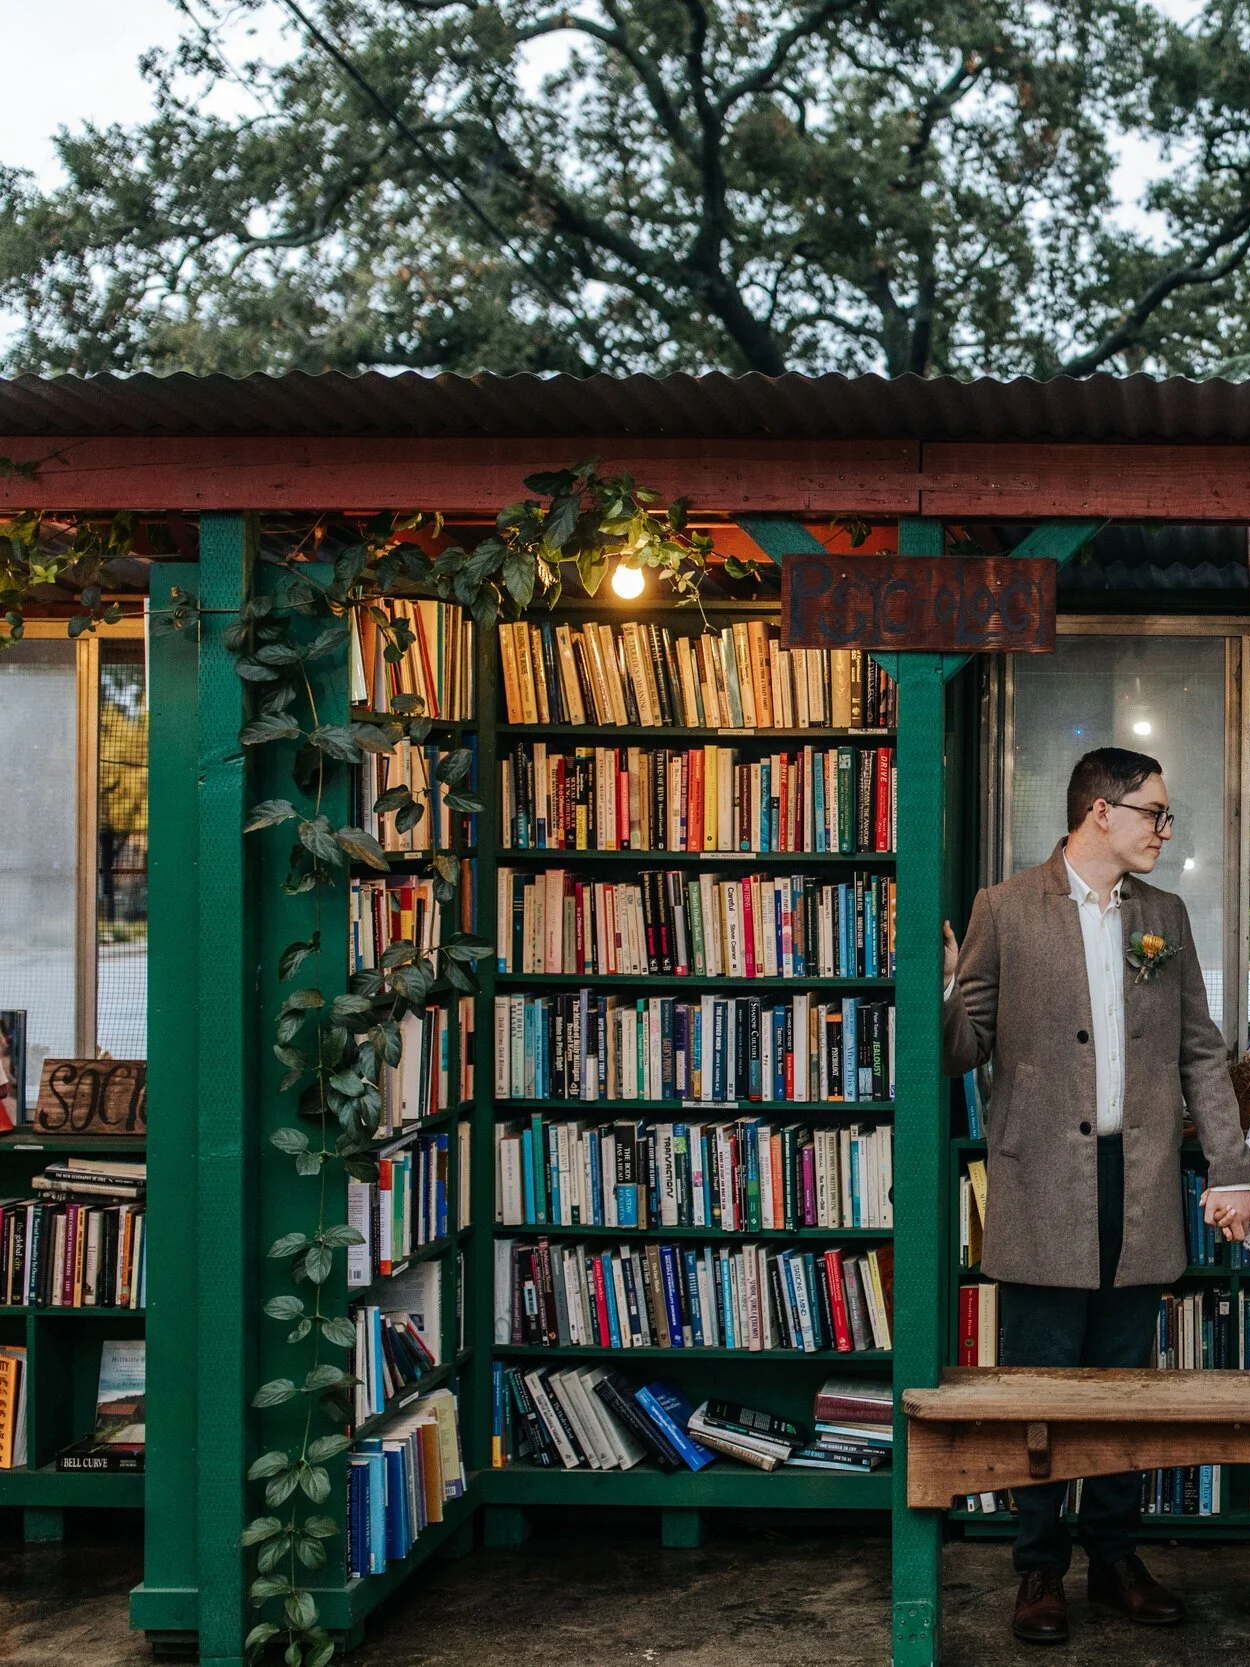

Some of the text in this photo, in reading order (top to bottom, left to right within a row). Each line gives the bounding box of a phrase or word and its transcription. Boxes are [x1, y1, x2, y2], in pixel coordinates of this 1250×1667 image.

[630, 644, 647, 712] POLITICS MEANING
[656, 753, 664, 777] FRAMES
[880, 755, 888, 783] DRIVE
[727, 886, 735, 912] Careful
[572, 1000, 580, 1012] The
[555, 1016, 563, 1035] Hidden
[566, 1022, 574, 1043] Daniel
[572, 1012, 580, 1031] Minds
[750, 1002, 760, 1058] SHADOW CULTURE
[555, 1057, 563, 1071] Sight
[571, 1054, 580, 1082] Milligan
[831, 1047, 839, 1076] PSYCHOLOGY
[872, 1040, 881, 1077] JEALOUSY
[624, 1162, 632, 1180] BODY
[664, 1136, 674, 1199] TRANSACTIONS
[624, 1189, 632, 1213] GUSTAV
[14, 1222, 24, 1271] the global city
[87, 1245, 96, 1271] Home
[543, 1250, 551, 1276] Publication
[793, 1264, 808, 1316] STATIONS MIND
[63, 1458, 108, 1468] BELL CURVE
